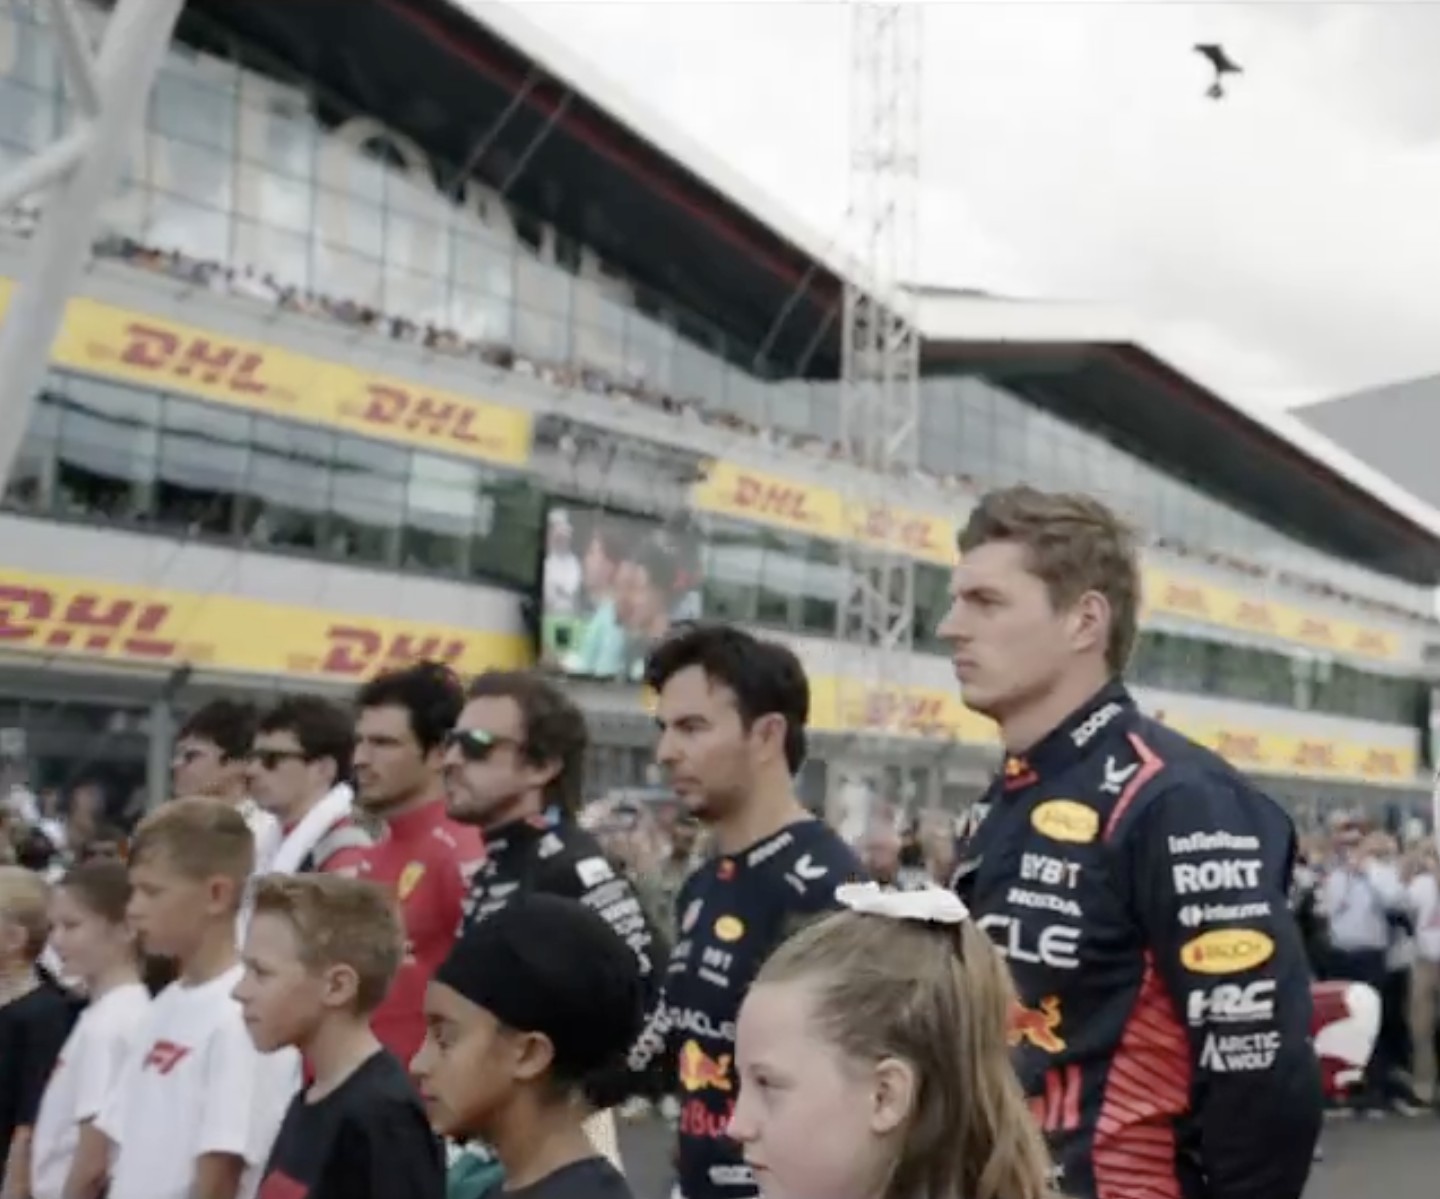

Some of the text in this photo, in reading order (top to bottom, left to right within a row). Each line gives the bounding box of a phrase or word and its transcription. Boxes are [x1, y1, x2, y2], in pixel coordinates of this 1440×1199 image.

[121, 321, 268, 393] DHL
[360, 383, 480, 444] DHL
[733, 474, 806, 522] DHL
[0, 583, 176, 657] DHL
[1173, 859, 1264, 894] ROKT
[1187, 980, 1277, 1016] HRC
[1219, 1031, 1281, 1053] ARCTIC
[1226, 1050, 1276, 1070] WOLF
